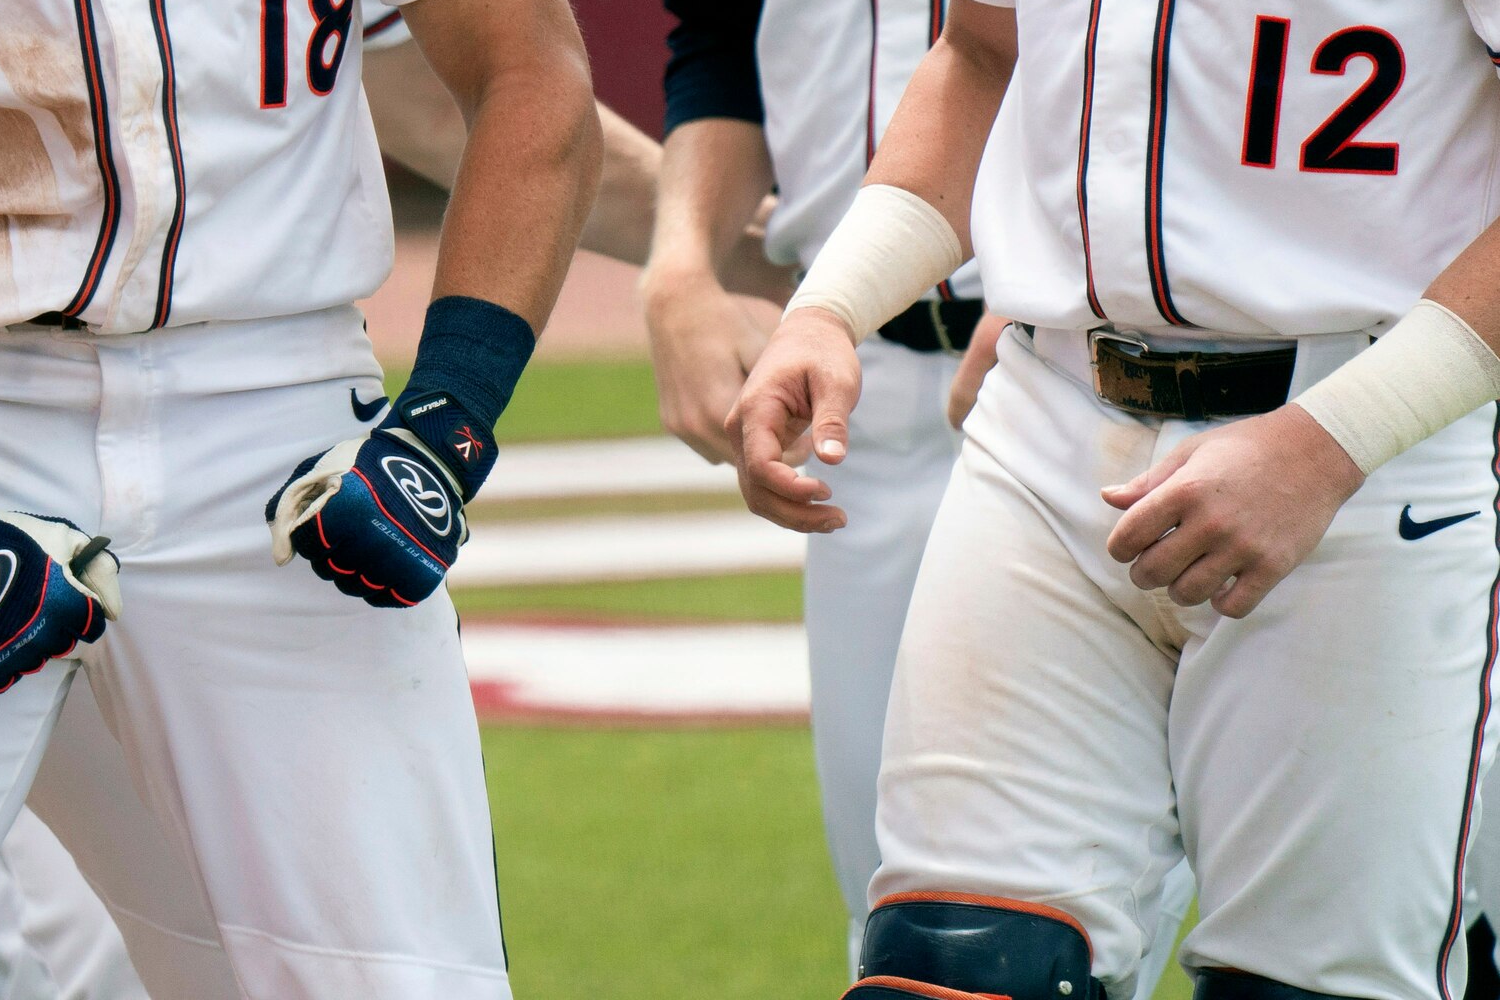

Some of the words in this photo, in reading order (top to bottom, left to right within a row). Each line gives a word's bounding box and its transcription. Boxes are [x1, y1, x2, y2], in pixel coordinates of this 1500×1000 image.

[1240, 15, 1407, 175] 12
[411, 397, 448, 417] RAWLINGS
[371, 518, 407, 547] SYSTEM
[405, 547, 420, 558] FIT
[11, 618, 47, 653] DYNAMIC
